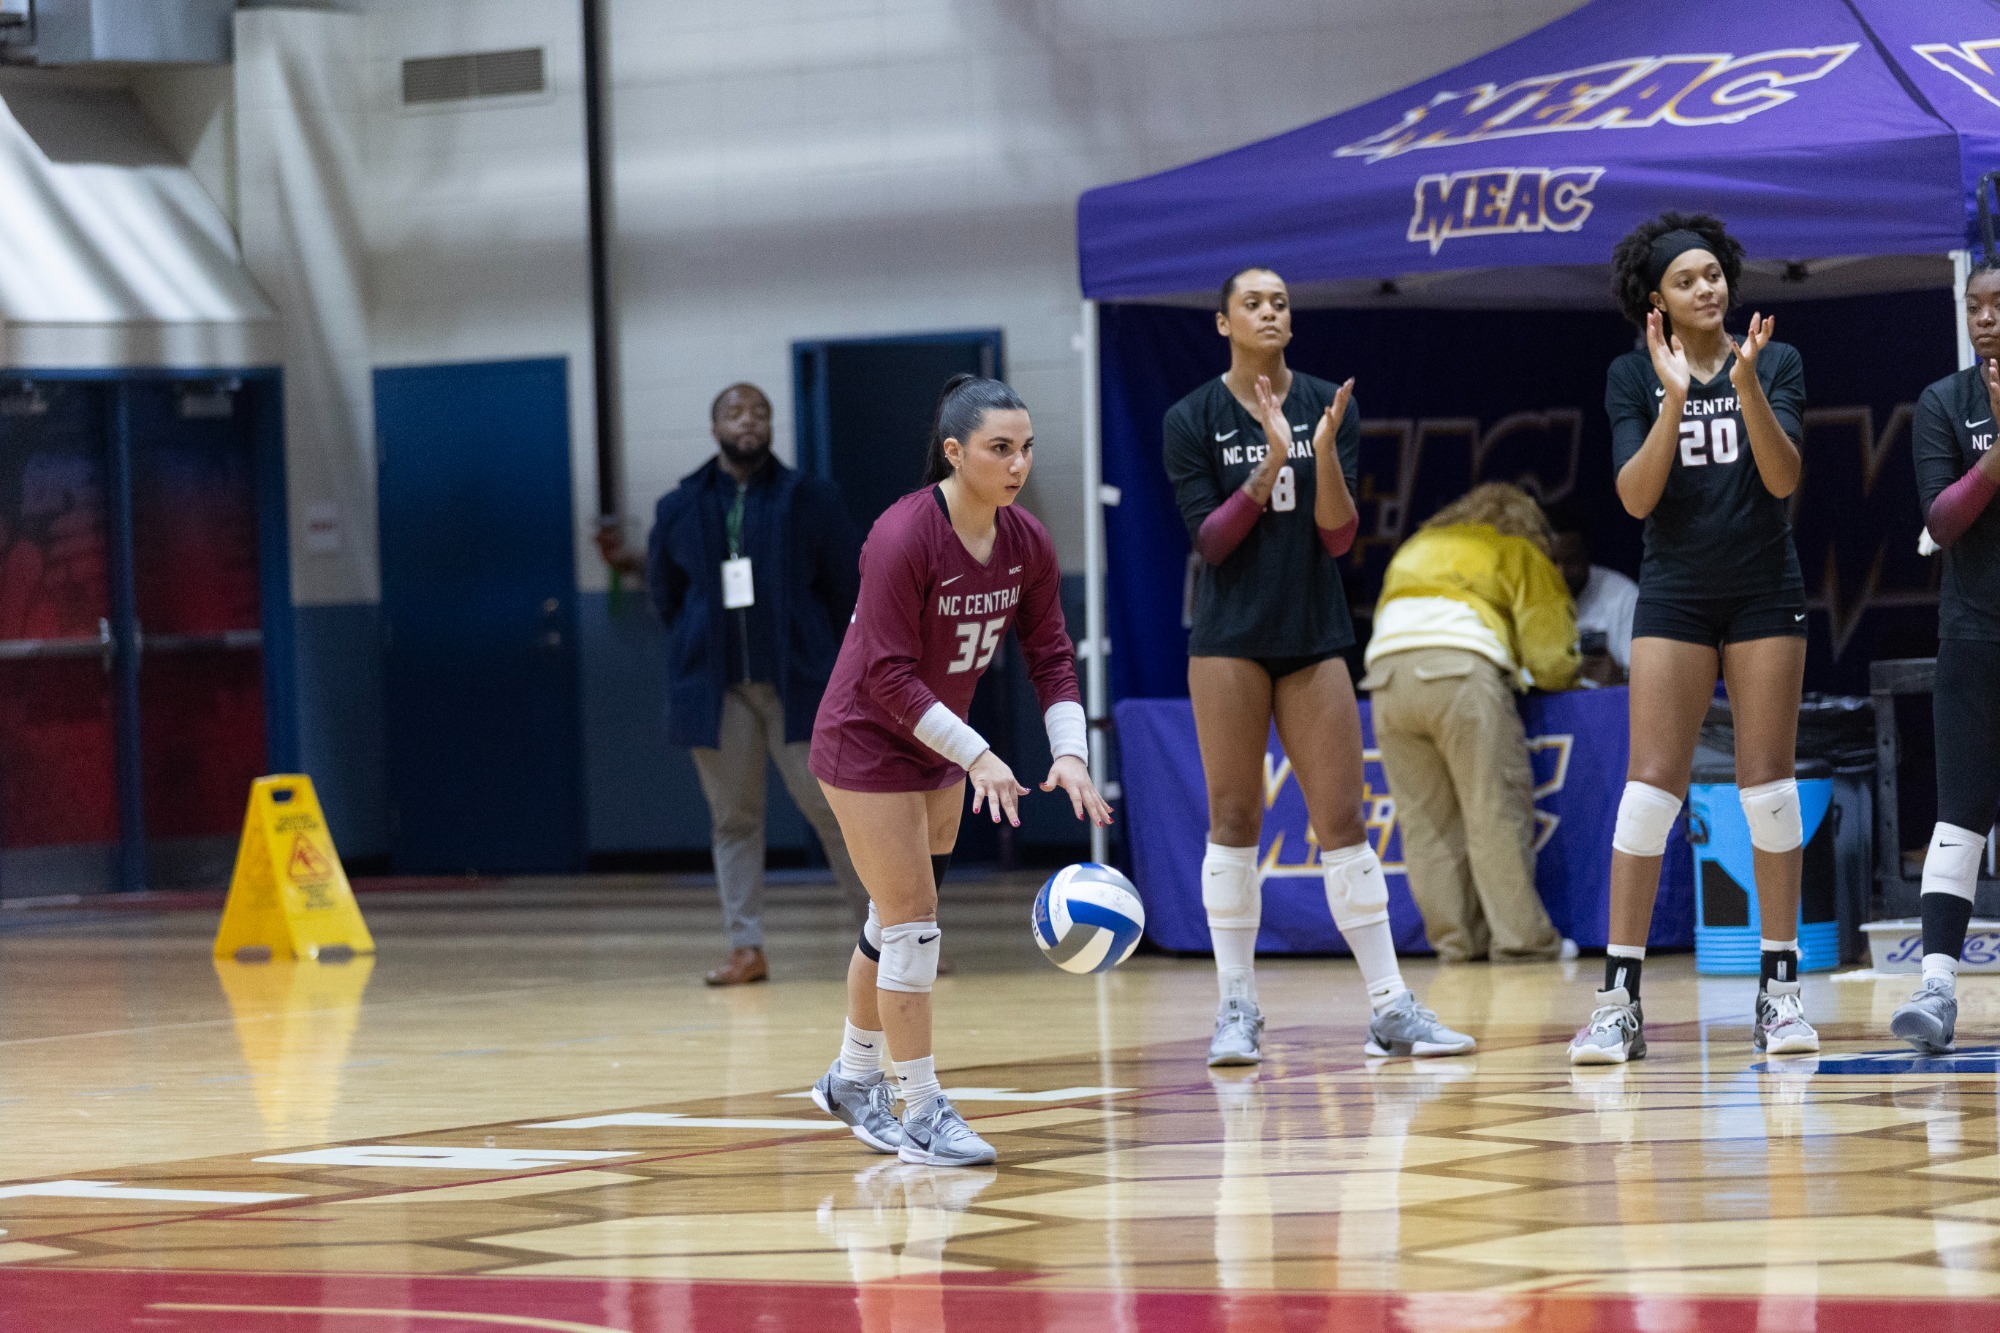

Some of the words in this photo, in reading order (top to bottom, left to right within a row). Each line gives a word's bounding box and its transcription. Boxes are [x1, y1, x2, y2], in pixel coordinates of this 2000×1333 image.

[1332, 42, 1861, 164] MEAC
[1407, 166, 1606, 255] MEAC
[1683, 396, 1742, 416] CENTRA
[1222, 445, 1243, 466] NC
[1246, 440, 1314, 463] CERAL
[1679, 417, 1739, 467] 20
[1972, 433, 1993, 451] NC
[938, 595, 962, 616] NC
[965, 584, 1021, 615] CENTRAL
[946, 615, 1007, 675] 35
